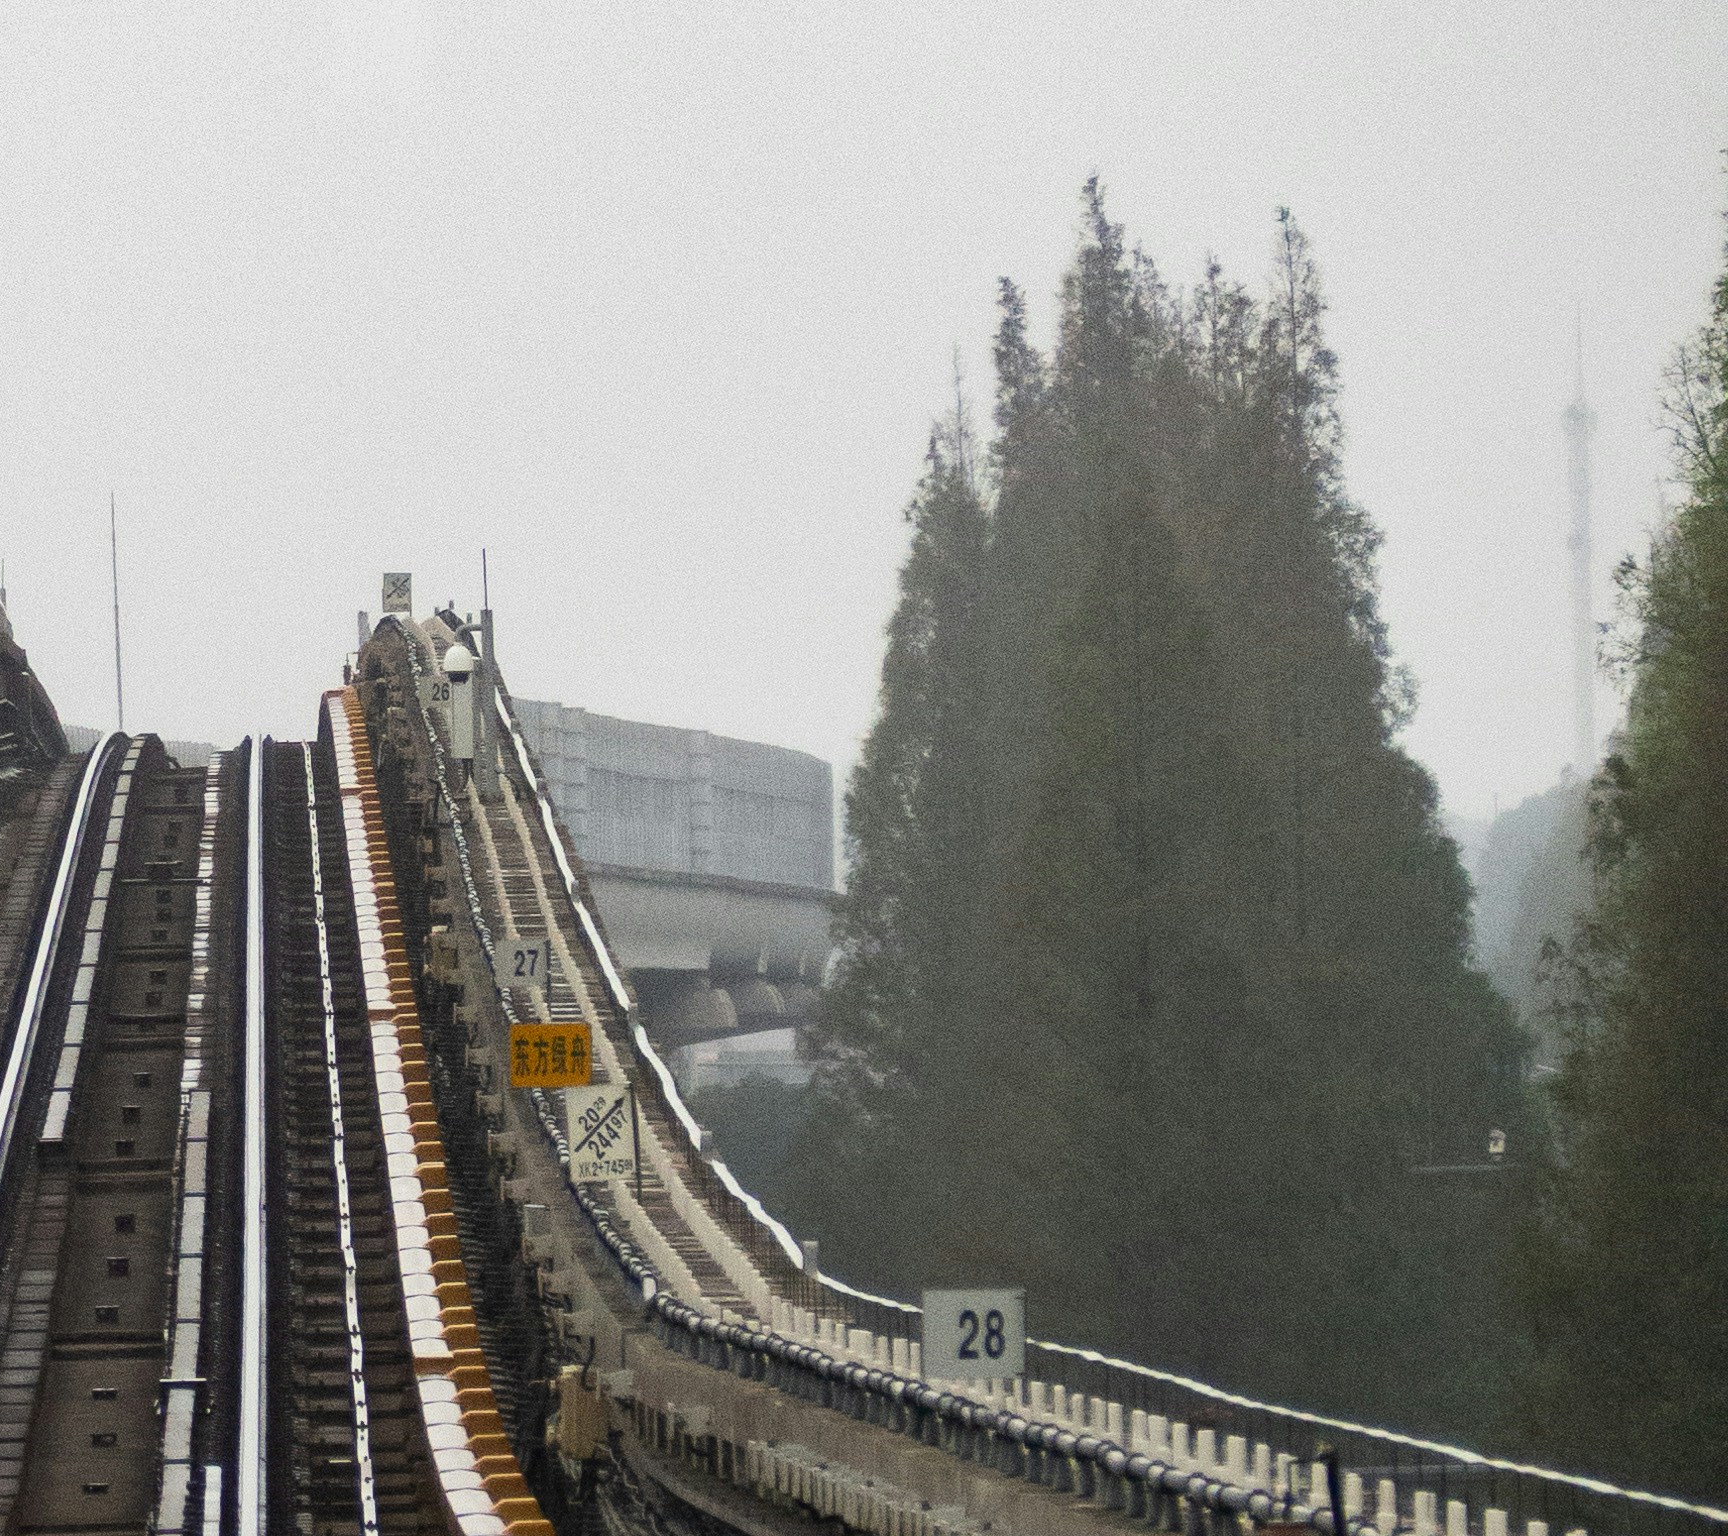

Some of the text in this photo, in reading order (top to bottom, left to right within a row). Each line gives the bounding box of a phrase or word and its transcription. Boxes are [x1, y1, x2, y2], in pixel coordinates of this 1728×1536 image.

[432, 682, 450, 701] 26
[514, 948, 539, 977] 27
[514, 1034, 587, 1077] 东方绿舟
[958, 1309, 1006, 1360] 28
